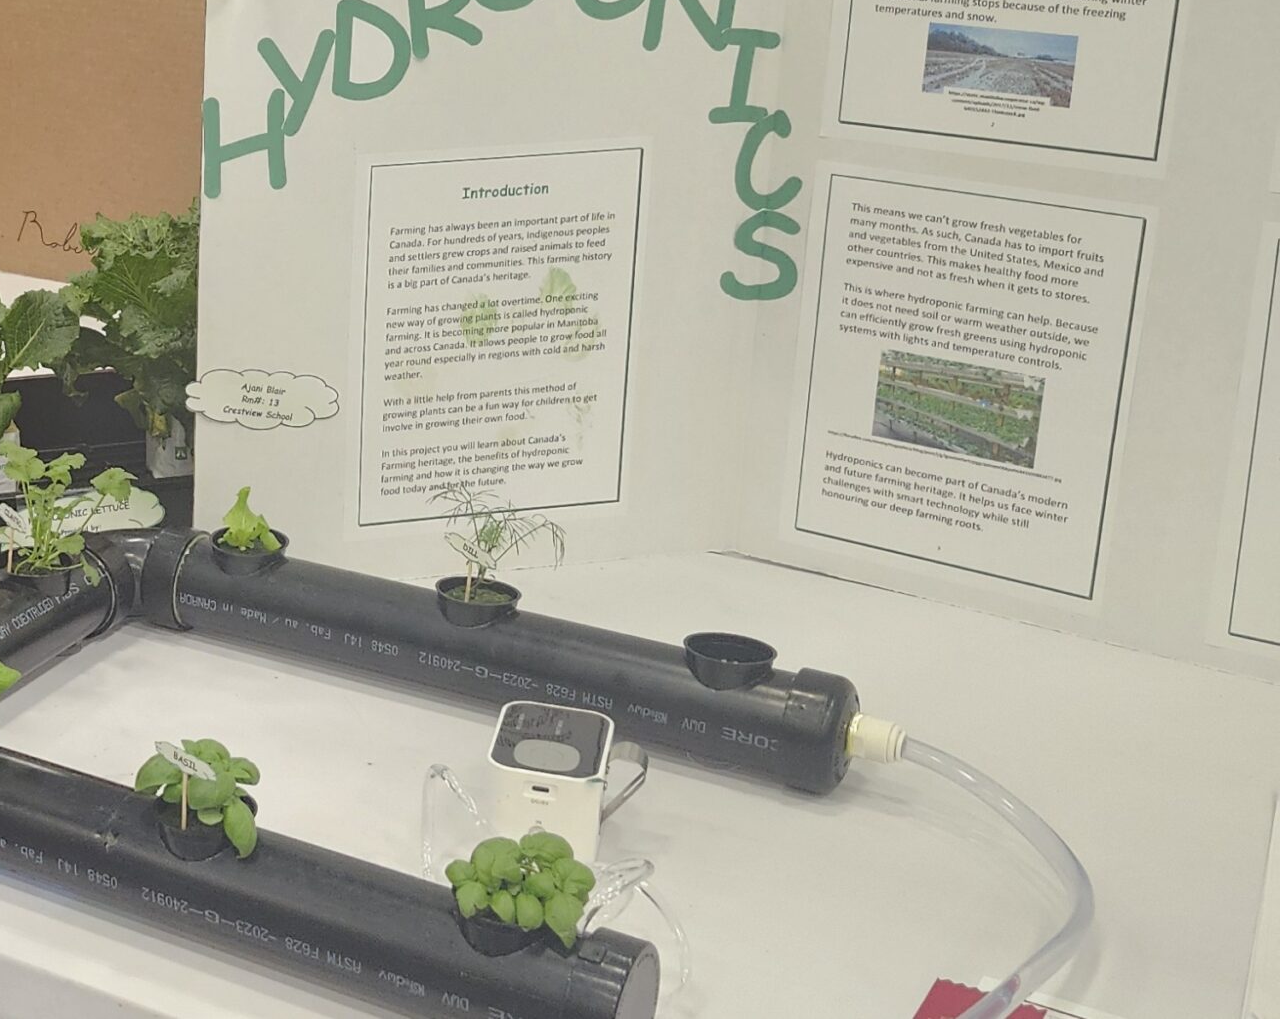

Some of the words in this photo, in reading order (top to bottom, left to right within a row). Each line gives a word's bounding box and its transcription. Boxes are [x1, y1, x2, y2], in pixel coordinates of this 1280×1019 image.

[461, 183, 549, 200] Introduction
[388, 266, 409, 276] their
[411, 263, 446, 274] families
[447, 261, 464, 272] and
[466, 258, 524, 270] communities.
[527, 256, 545, 265] This
[546, 254, 580, 264] farming
[581, 252, 612, 261] history
[839, 323, 877, 337] systems
[878, 330, 901, 341] with
[902, 332, 929, 346] lights
[930, 340, 950, 350] and
[952, 342, 1015, 362] temperature
[1017, 355, 1062, 370] controls.
[241, 383, 263, 393] Ajani
[266, 385, 286, 395] Blair
[269, 398, 280, 407] 13
[223, 405, 262, 418] Crestview
[265, 411, 293, 421] School
[381, 461, 416, 471] Farming
[417, 457, 456, 467] heritage,
[457, 454, 473, 464] the
[474, 450, 509, 462] benefits
[510, 449, 520, 459] of
[521, 447, 569, 459] hydroponic
[825, 450, 883, 470] Hydroponics
[884, 464, 902, 474] can
[904, 466, 943, 482] become
[944, 477, 966, 488] part
[967, 481, 979, 490] of
[980, 483, 1025, 501] Canada's
[1027, 494, 1068, 510] modern
[91, 501, 130, 515] LETTUCE
[463, 543, 479, 558] DILL
[179, 592, 217, 612] CANADA
[222, 602, 234, 613] in
[240, 607, 267, 624] Made
[285, 618, 299, 629] au
[344, 632, 363, 648] 14J
[371, 640, 399, 657] 0548
[546, 683, 577, 701] F628
[582, 692, 613, 710] ASTM
[173, 750, 199, 773] BASIL
[57, 857, 79, 876] 14J
[87, 868, 118, 890] 0548
[284, 937, 320, 960] F628
[326, 950, 362, 974] ASTM
